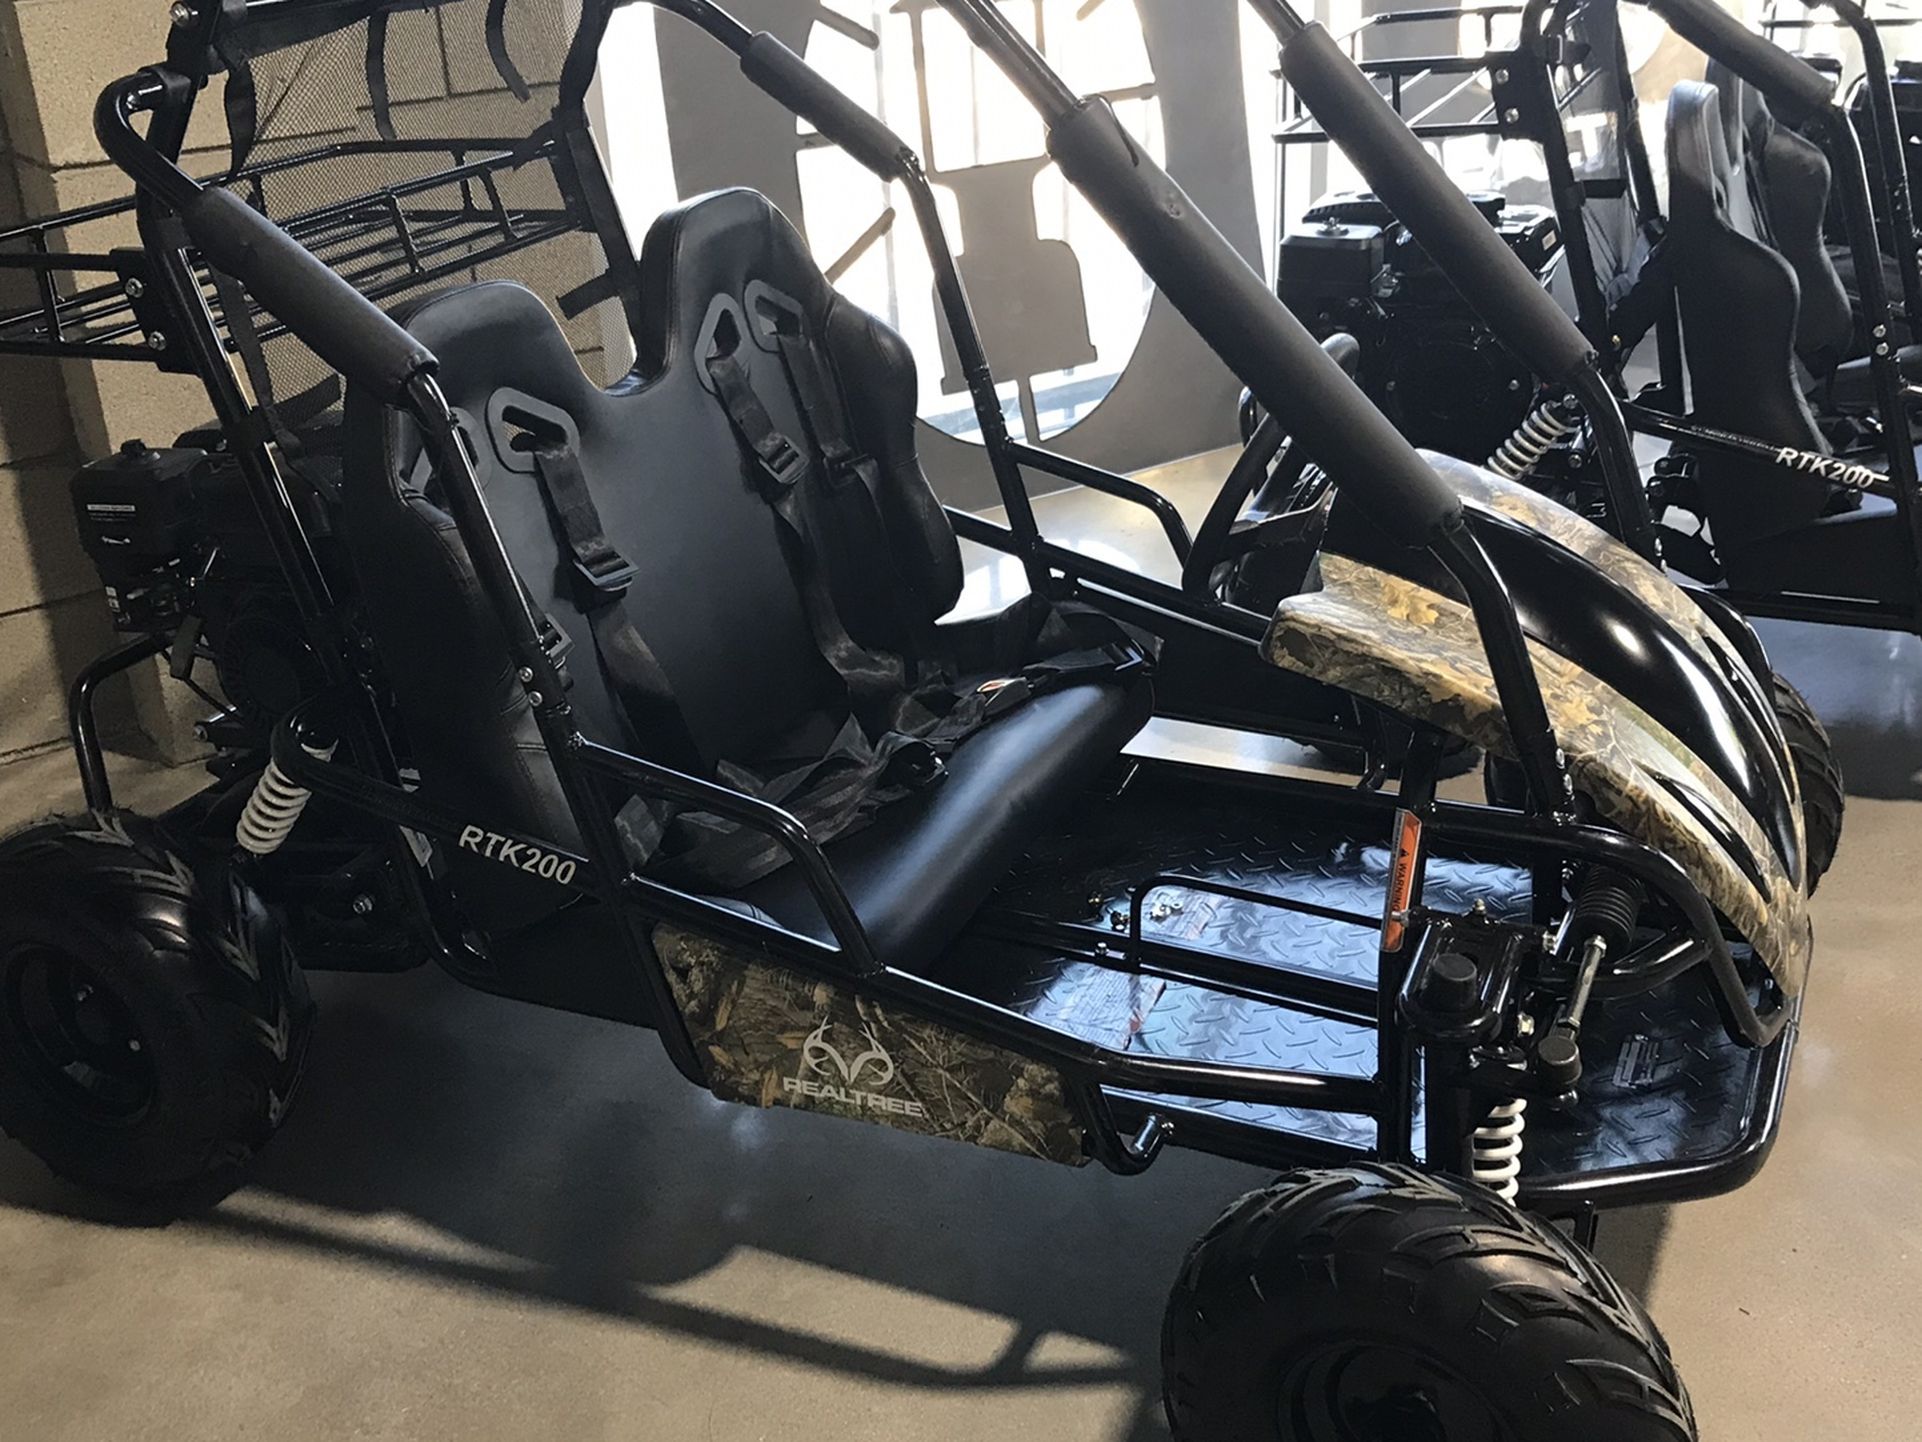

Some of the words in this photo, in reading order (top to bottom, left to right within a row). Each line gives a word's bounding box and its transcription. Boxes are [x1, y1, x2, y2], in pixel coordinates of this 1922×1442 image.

[1775, 447, 1875, 488] RTK200
[458, 824, 577, 885] RTK200
[1392, 863, 1407, 911] WARNING
[782, 1076, 923, 1118] REALTREE
